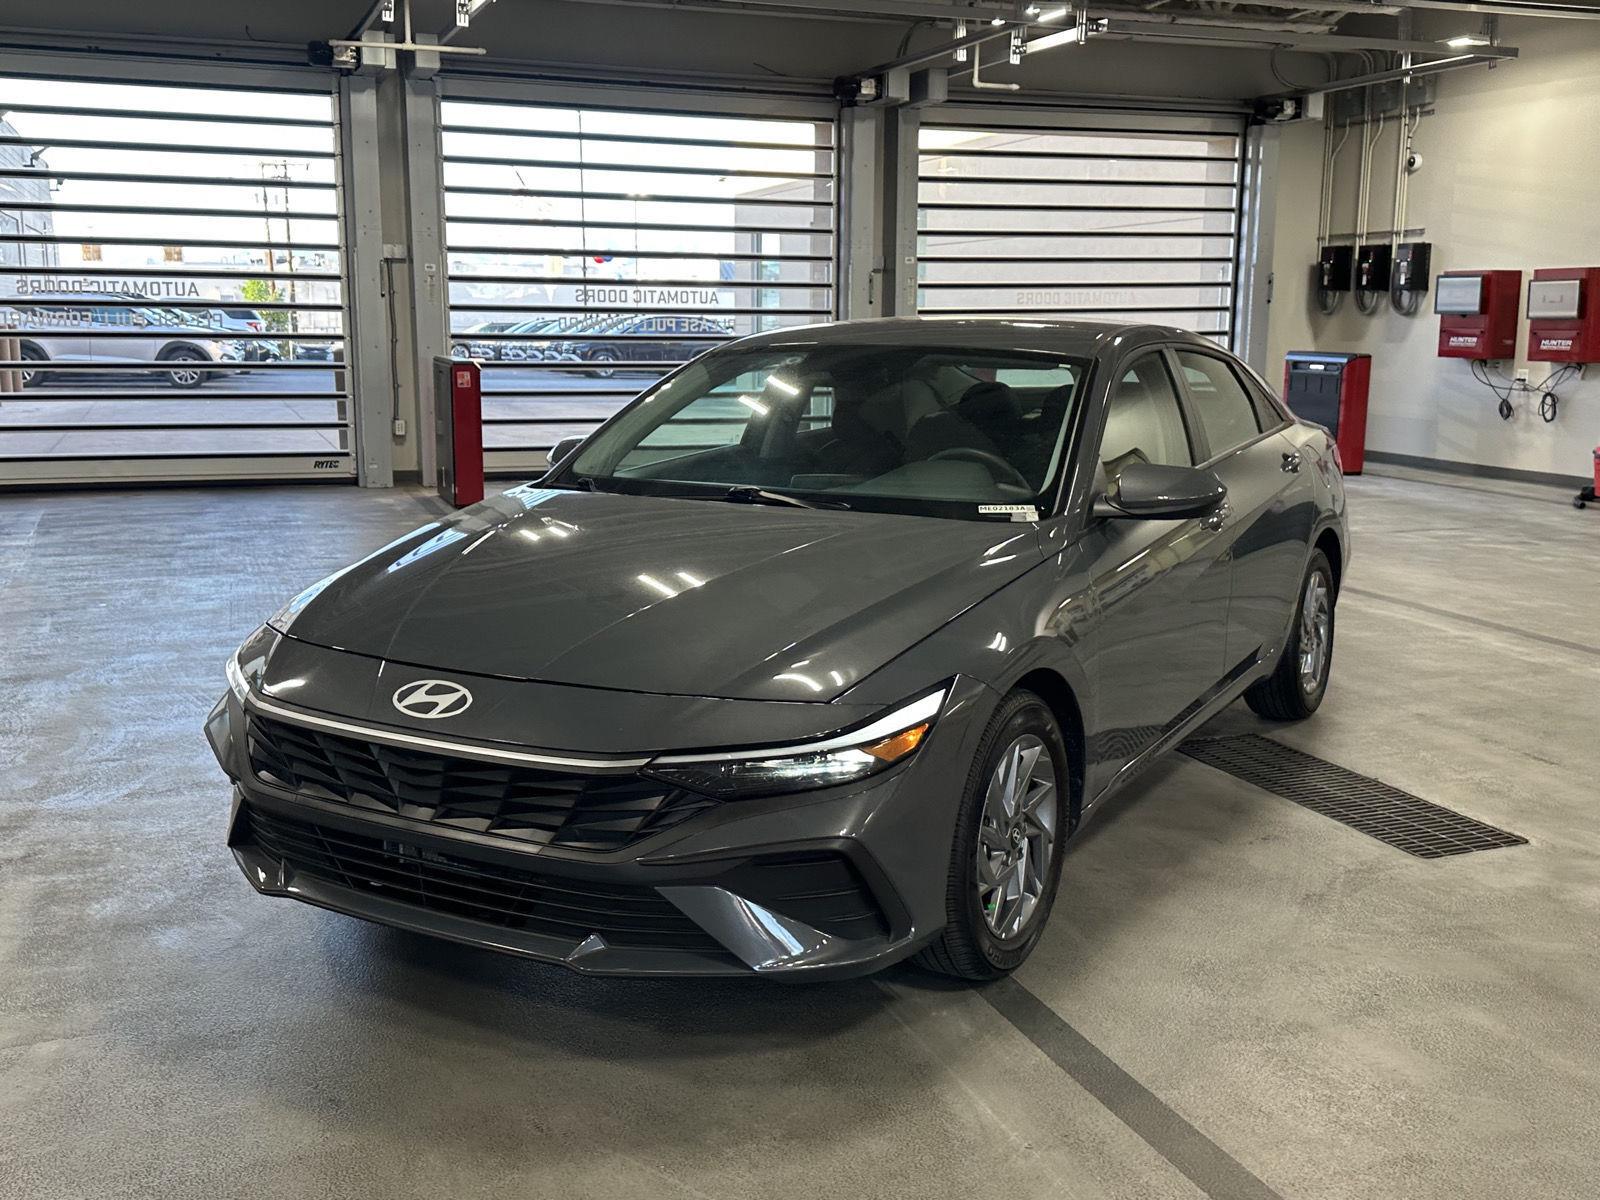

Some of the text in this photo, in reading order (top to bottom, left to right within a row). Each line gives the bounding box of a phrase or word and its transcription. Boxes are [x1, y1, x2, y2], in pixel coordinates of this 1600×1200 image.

[1449, 336, 1478, 344] HUNTER
[1541, 339, 1572, 347] HUNTER
[313, 460, 340, 469] RYTEC
